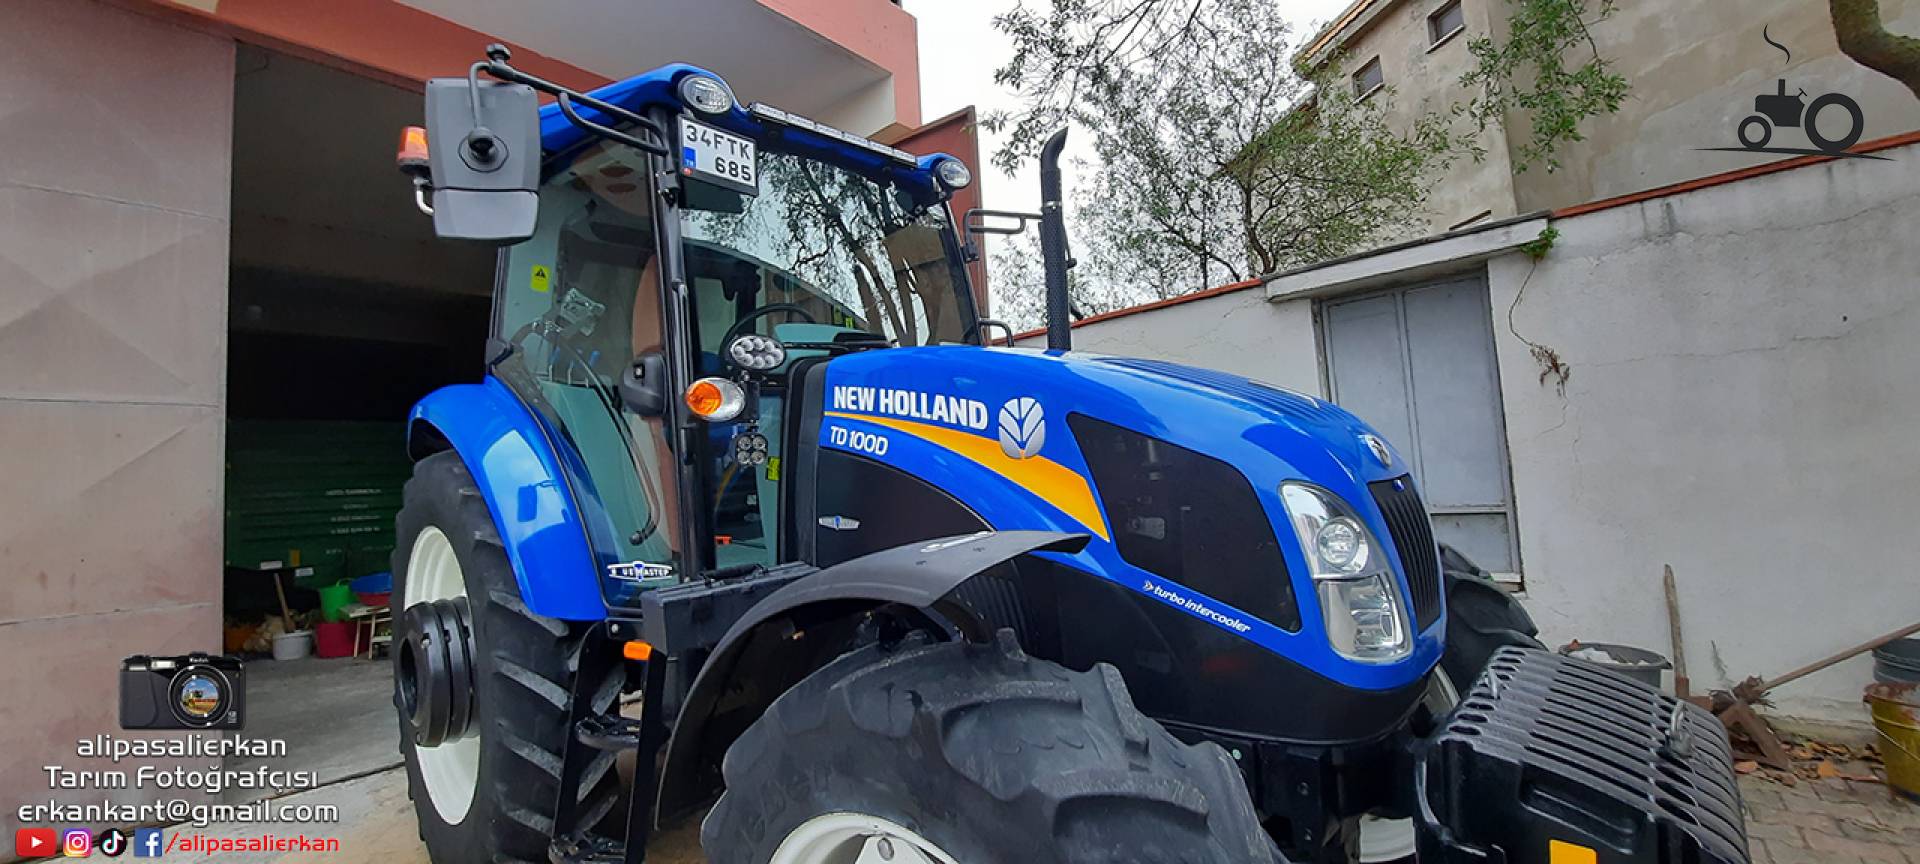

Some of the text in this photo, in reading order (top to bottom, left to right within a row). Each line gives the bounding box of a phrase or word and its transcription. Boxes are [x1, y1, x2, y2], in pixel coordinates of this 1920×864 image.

[686, 125, 751, 160] 34FTK
[715, 156, 752, 181] 685
[833, 386, 989, 431] NEW HOLLAND
[830, 425, 889, 456] TD 100D
[1154, 585, 1251, 633] turbo intercooler
